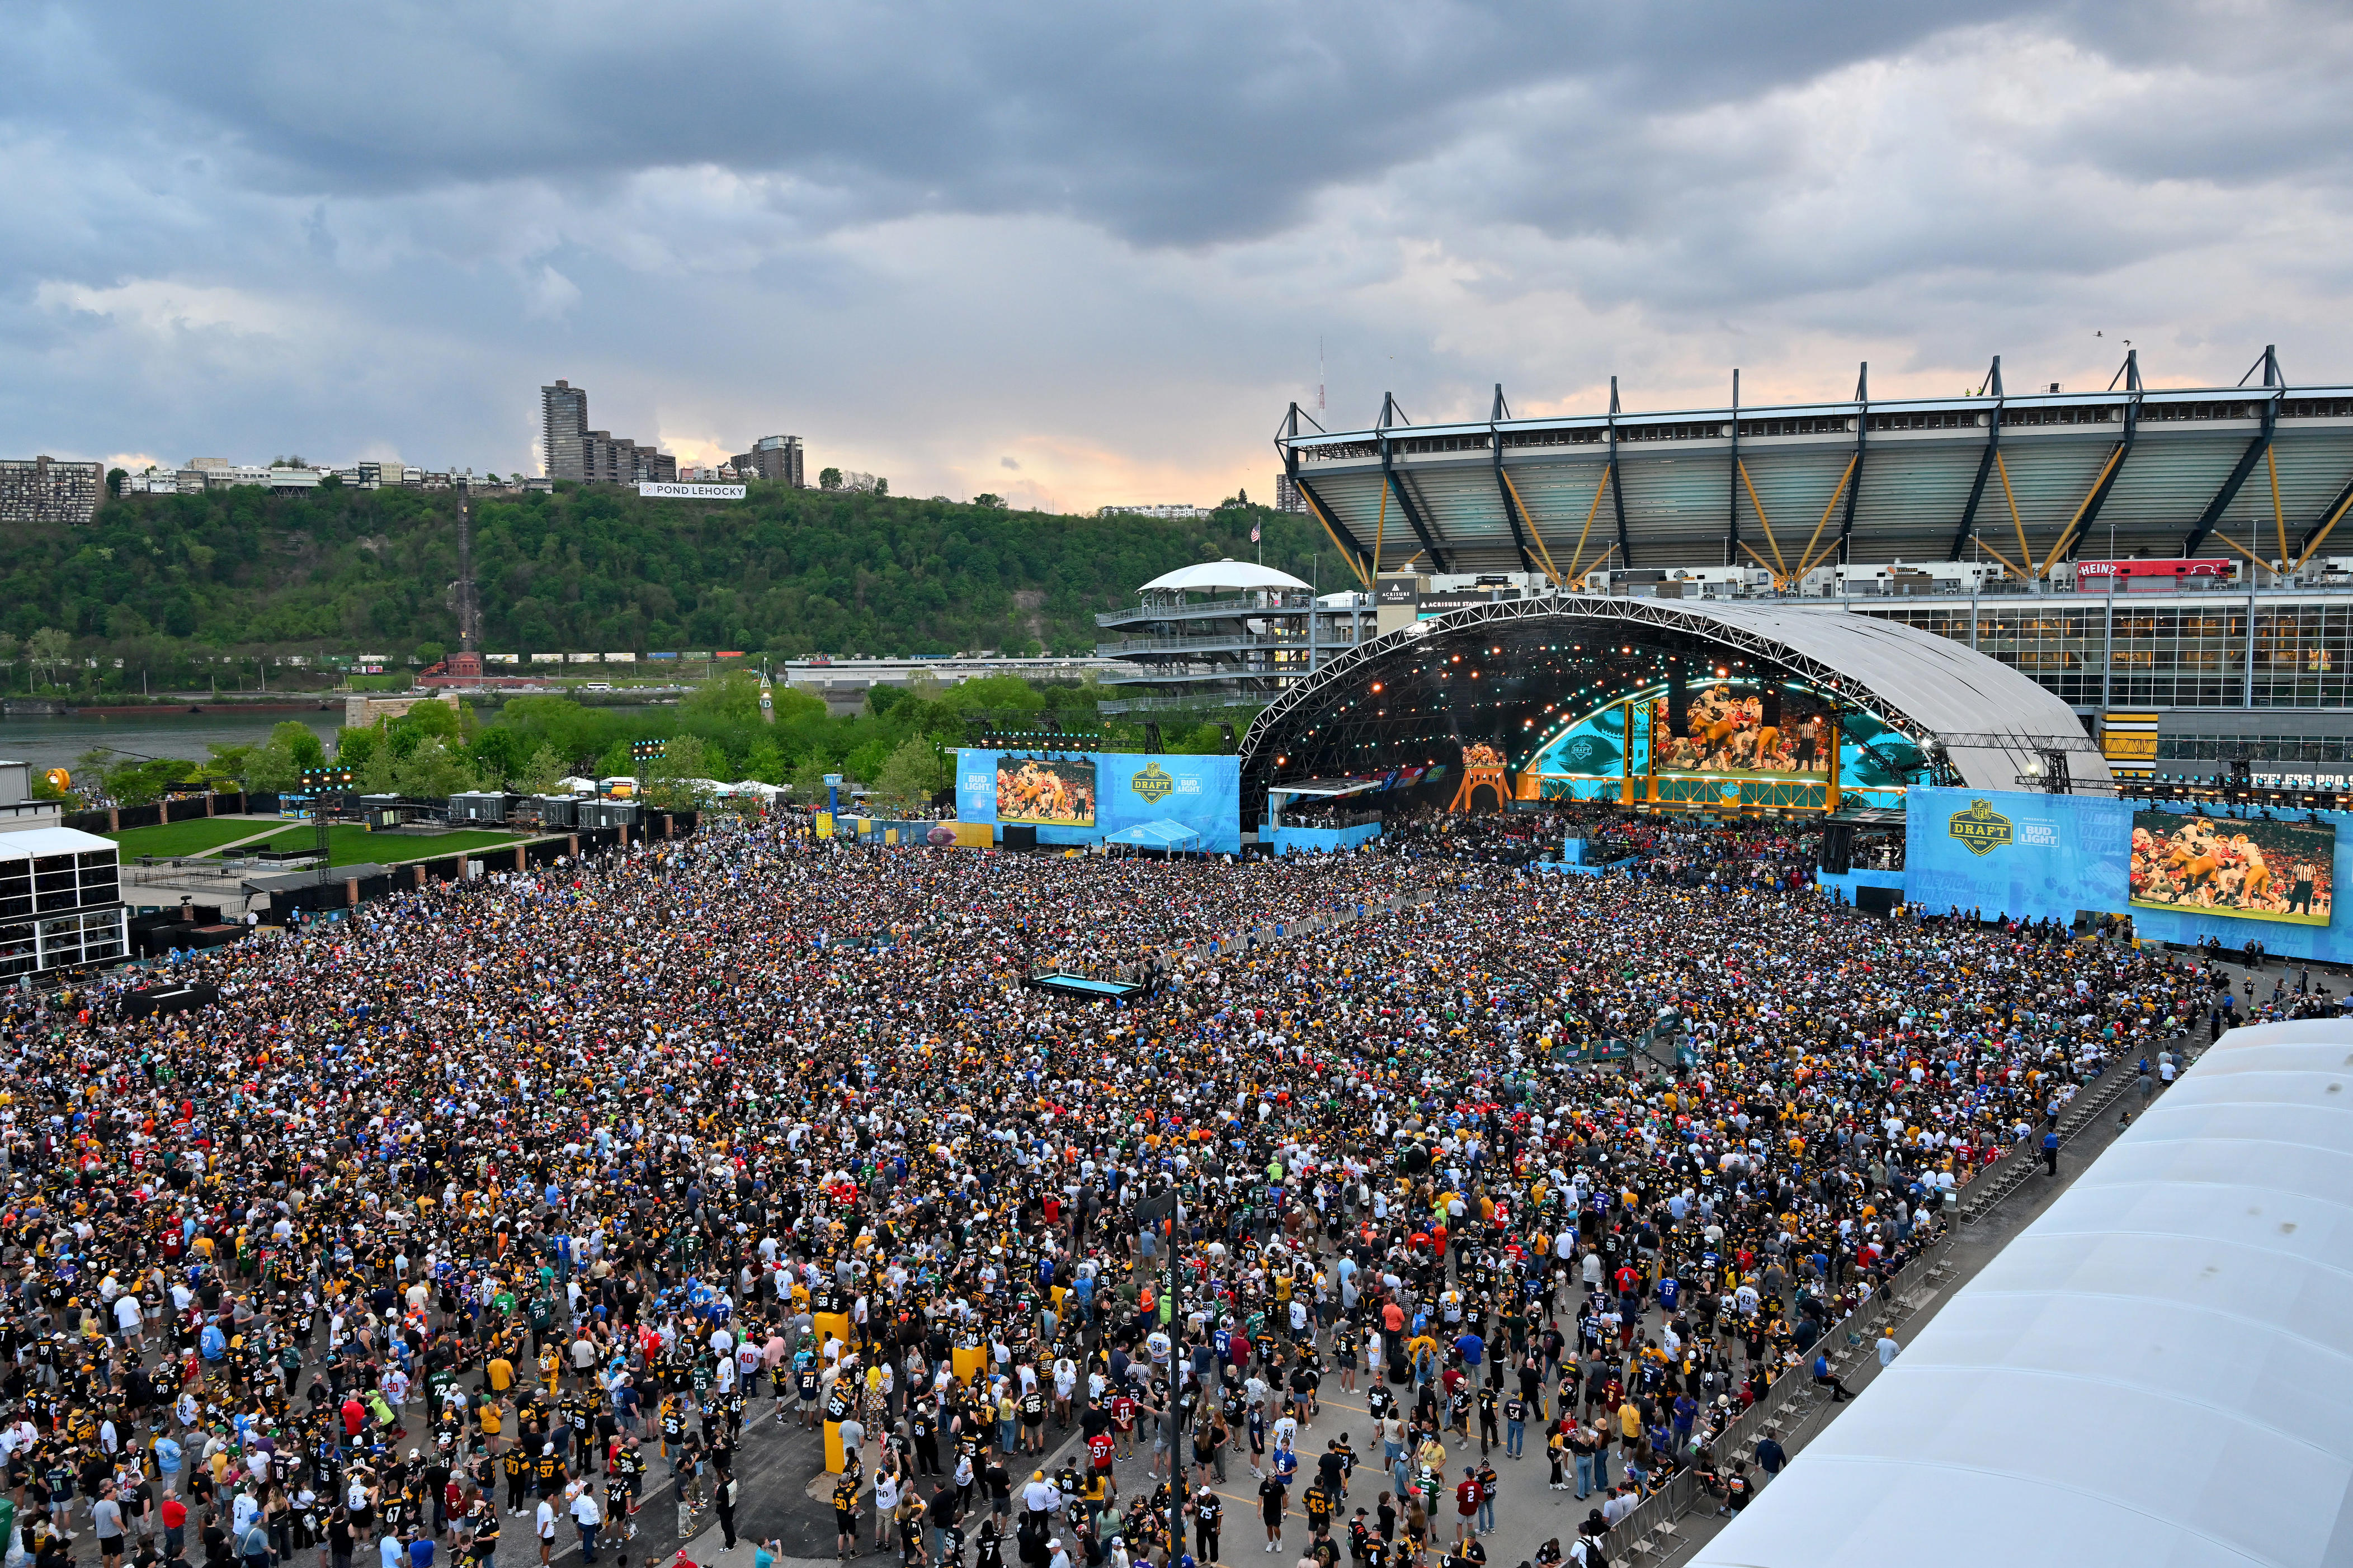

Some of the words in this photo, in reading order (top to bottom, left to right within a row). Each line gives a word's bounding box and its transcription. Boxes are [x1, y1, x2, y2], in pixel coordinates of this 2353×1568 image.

[657, 486, 689, 494] POND
[692, 487, 743, 495] LEHOCKY
[2081, 564, 2117, 575] HEINZ
[2250, 773, 2312, 785] TEELERS
[2316, 774, 2344, 786] PRO
[1974, 808, 1987, 817] NFL
[1954, 823, 2007, 837] DRAFT
[2026, 825, 2052, 835] BUD
[2021, 833, 2057, 845] LIGHT
[134, 1157, 143, 1165] 15
[1384, 1155, 1393, 1164] 58
[1702, 1175, 1711, 1185] 87
[819, 1199, 827, 1208] 30
[166, 1236, 177, 1246] 42
[1245, 1251, 1255, 1260] 43
[1100, 1276, 1110, 1284] 90
[1475, 1273, 1484, 1282] 33
[50, 1288, 61, 1297] 90
[1665, 1287, 1673, 1296] 17
[1596, 1299, 1604, 1310] 18
[1741, 1295, 1751, 1305] 43
[1267, 1306, 1272, 1315] 5
[1422, 1304, 1433, 1315] 88
[1769, 1302, 1779, 1312] 90
[1586, 1326, 1597, 1338] 82
[1053, 1343, 1063, 1356] 97
[1153, 1342, 1161, 1351] 58
[1215, 1340, 1225, 1350] 44
[1340, 1341, 1346, 1351] 8
[40, 1346, 49, 1355] 19
[99, 1349, 107, 1359] 43
[741, 1353, 753, 1363] 40
[1041, 1361, 1052, 1369] 84
[727, 1370, 731, 1380] 8
[1645, 1373, 1651, 1382] 3
[694, 1378, 706, 1388] 25
[803, 1377, 814, 1386] 21
[156, 1385, 168, 1394] 90
[266, 1385, 275, 1395] 88
[388, 1383, 398, 1392] 90
[435, 1385, 446, 1395] 72
[338, 1394, 347, 1404] 77
[1130, 1394, 1139, 1402] 52
[1371, 1394, 1382, 1405] 36
[1608, 1392, 1614, 1402] 5
[589, 1398, 601, 1409] 90
[730, 1399, 741, 1412] 43
[828, 1399, 843, 1415] 26
[1027, 1401, 1040, 1413] 95
[1482, 1399, 1487, 1409] 4
[178, 1406, 186, 1416] 92
[1510, 1409, 1520, 1419] 54
[575, 1419, 585, 1428] 58
[665, 1419, 677, 1433] 36
[915, 1425, 925, 1436] 50
[1284, 1429, 1293, 1439] 84
[1093, 1447, 1106, 1458] 97
[506, 1462, 518, 1474] 90
[621, 1460, 634, 1472] 26
[1278, 1460, 1285, 1471] 6
[276, 1467, 283, 1479] 18
[540, 1466, 554, 1477] 97
[52, 1480, 62, 1491] 11
[1063, 1480, 1072, 1490] 90
[611, 1491, 621, 1501] 24
[877, 1490, 888, 1498] 90
[1468, 1491, 1474, 1501] 2
[352, 1495, 356, 1504] 3
[835, 1499, 847, 1510] 90
[1309, 1498, 1325, 1513] 43
[238, 1508, 241, 1518] 1
[386, 1506, 400, 1522] 67
[1200, 1506, 1212, 1519] 75
[985, 1547, 993, 1560] 7
[1370, 1551, 1377, 1565] 4
